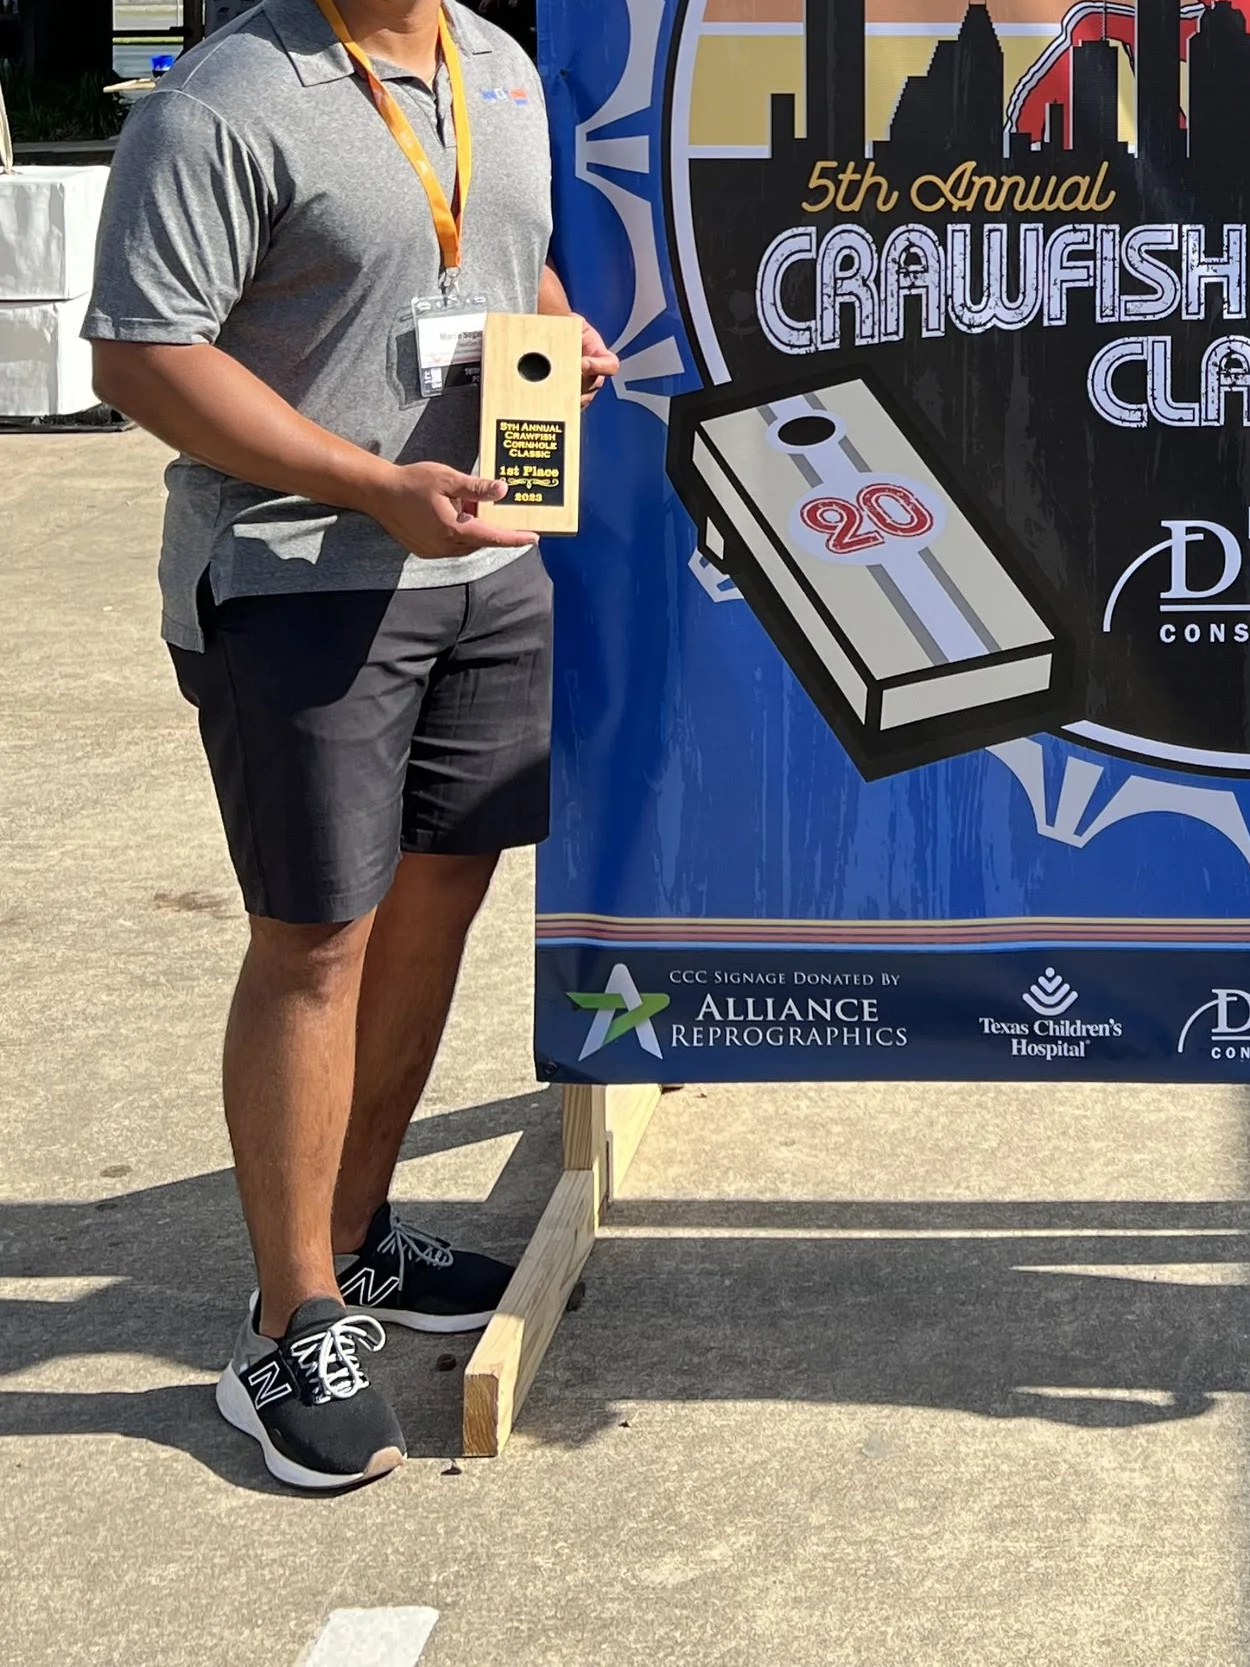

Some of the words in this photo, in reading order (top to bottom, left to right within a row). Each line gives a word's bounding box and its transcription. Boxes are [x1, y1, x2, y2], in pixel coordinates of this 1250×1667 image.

[801, 160, 899, 213] 5th
[910, 160, 1117, 213] Annual
[755, 222, 1248, 355] CRAWFISH
[504, 431, 556, 441] CRAWFISH
[521, 422, 563, 433] ANNUAL
[503, 439, 558, 450] CORNHOLE
[508, 448, 552, 459] CLASSIC
[499, 465, 520, 476] 1st
[522, 465, 560, 477] Place
[514, 492, 543, 502] 2023
[800, 482, 934, 555] 20
[669, 969, 708, 984] CCC
[714, 970, 786, 985] SIGNAGE
[793, 971, 874, 986] DONATED
[881, 972, 901, 986] BY
[695, 992, 879, 1022] ALLIANCE
[671, 1024, 908, 1047] REPROGRAPHICS
[978, 1017, 1029, 1035] Texas
[1033, 1018, 1123, 1037] Children's
[1011, 1038, 1086, 1061] Hospital
